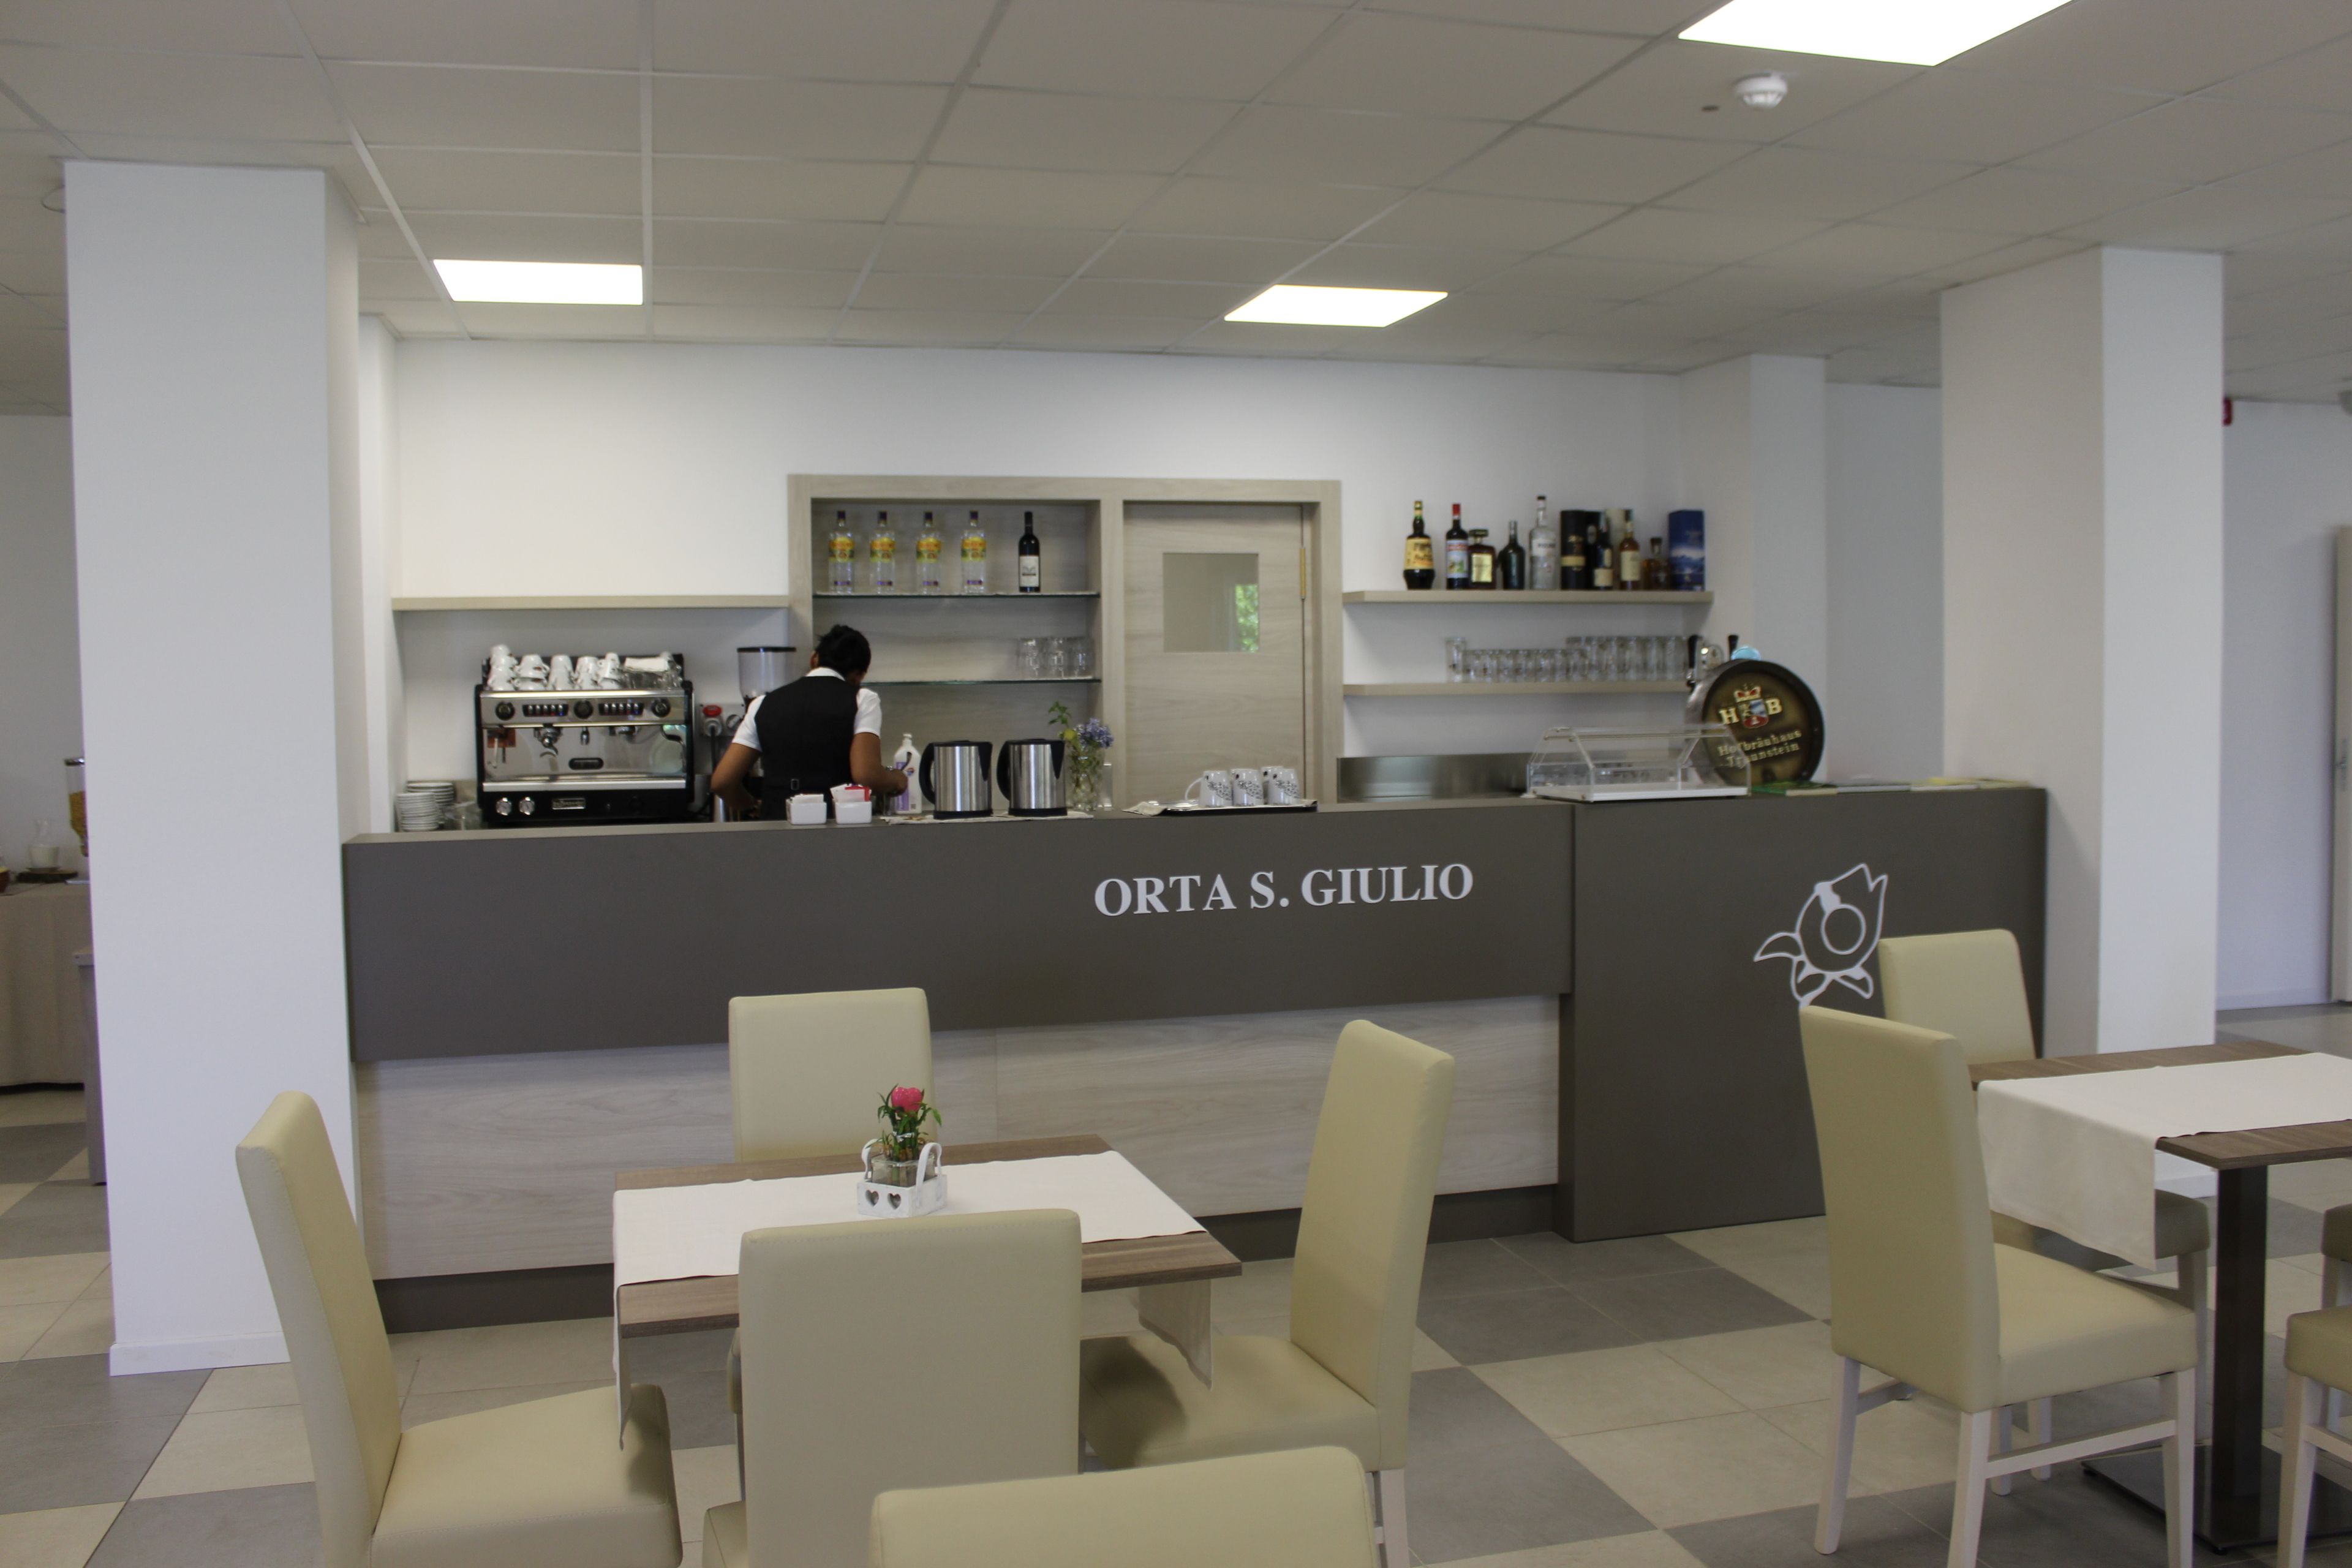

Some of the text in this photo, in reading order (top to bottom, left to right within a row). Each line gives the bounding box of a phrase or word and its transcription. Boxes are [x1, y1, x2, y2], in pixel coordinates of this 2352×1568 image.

[1719, 698, 1782, 725] H B
[1095, 864, 1472, 916] ORTA S. GIULIO
